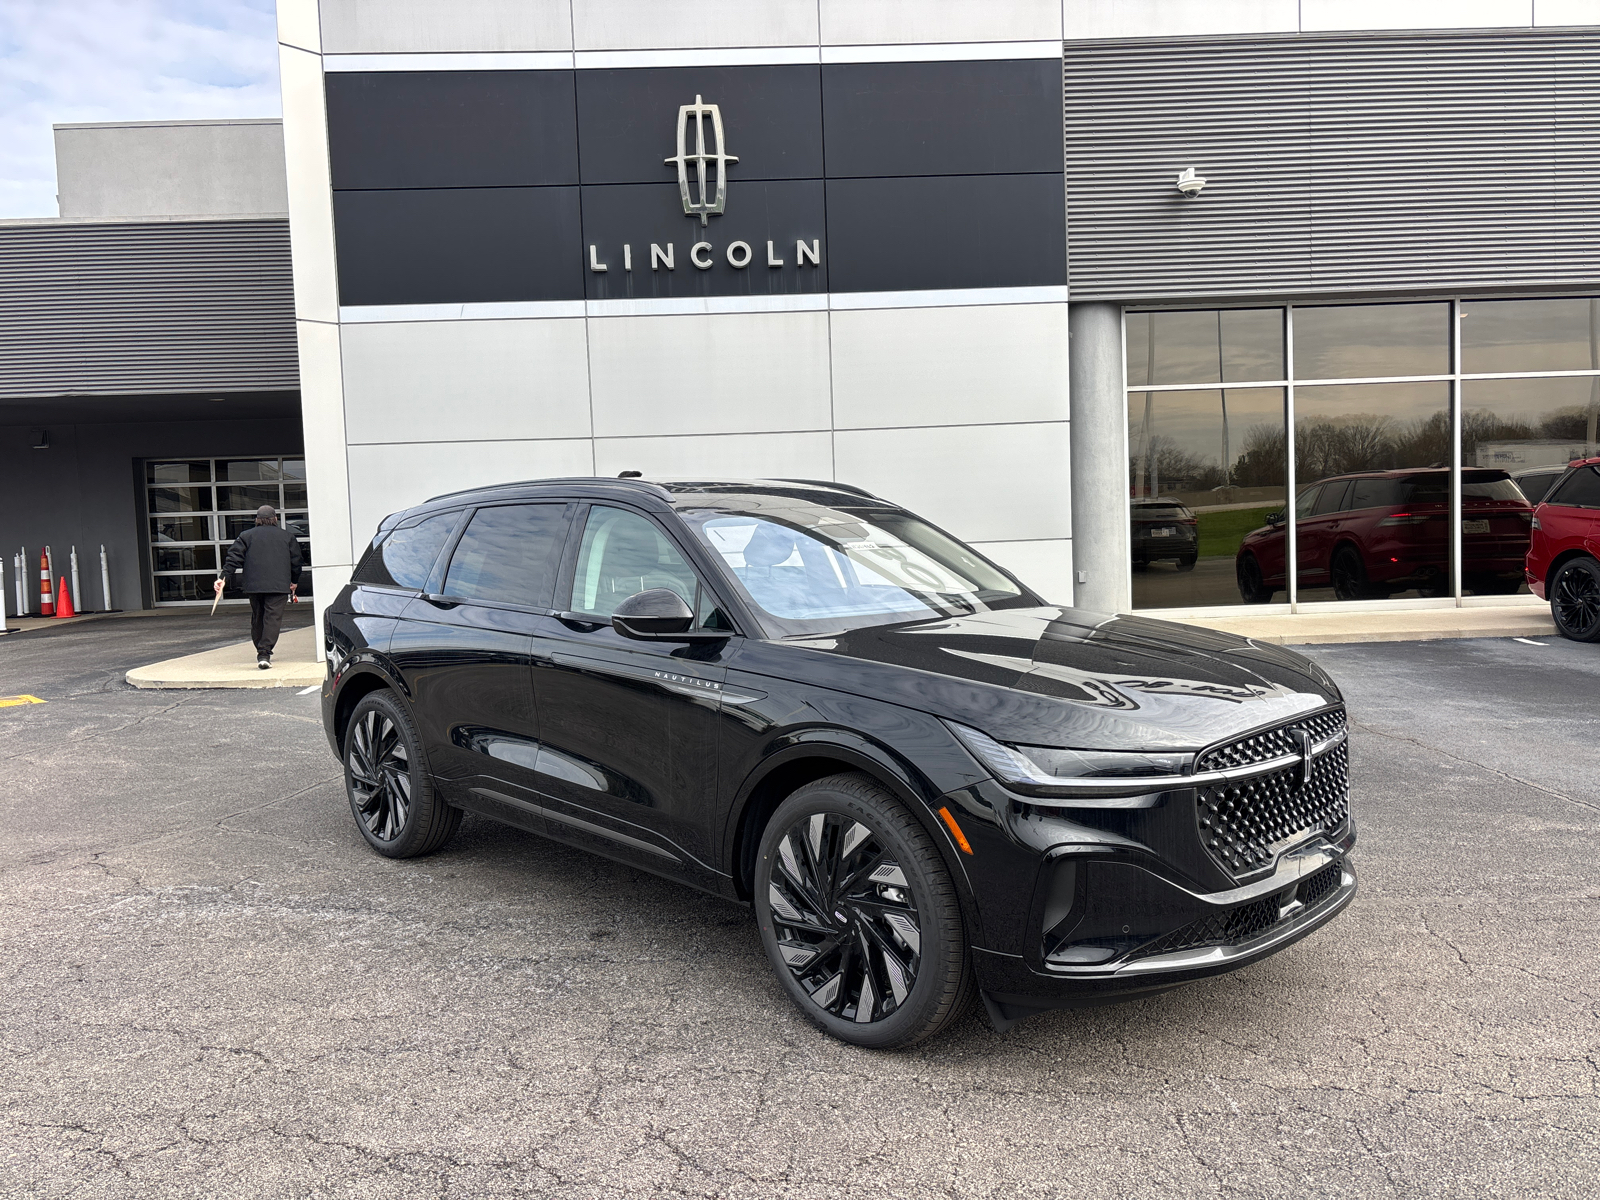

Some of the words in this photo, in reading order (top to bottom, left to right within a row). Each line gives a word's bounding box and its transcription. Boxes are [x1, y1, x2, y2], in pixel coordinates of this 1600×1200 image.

[590, 239, 820, 272] LINCOLN
[654, 671, 719, 689] NAUTILUS
[846, 801, 894, 837] EAGLE
[896, 843, 932, 926] TOURING
